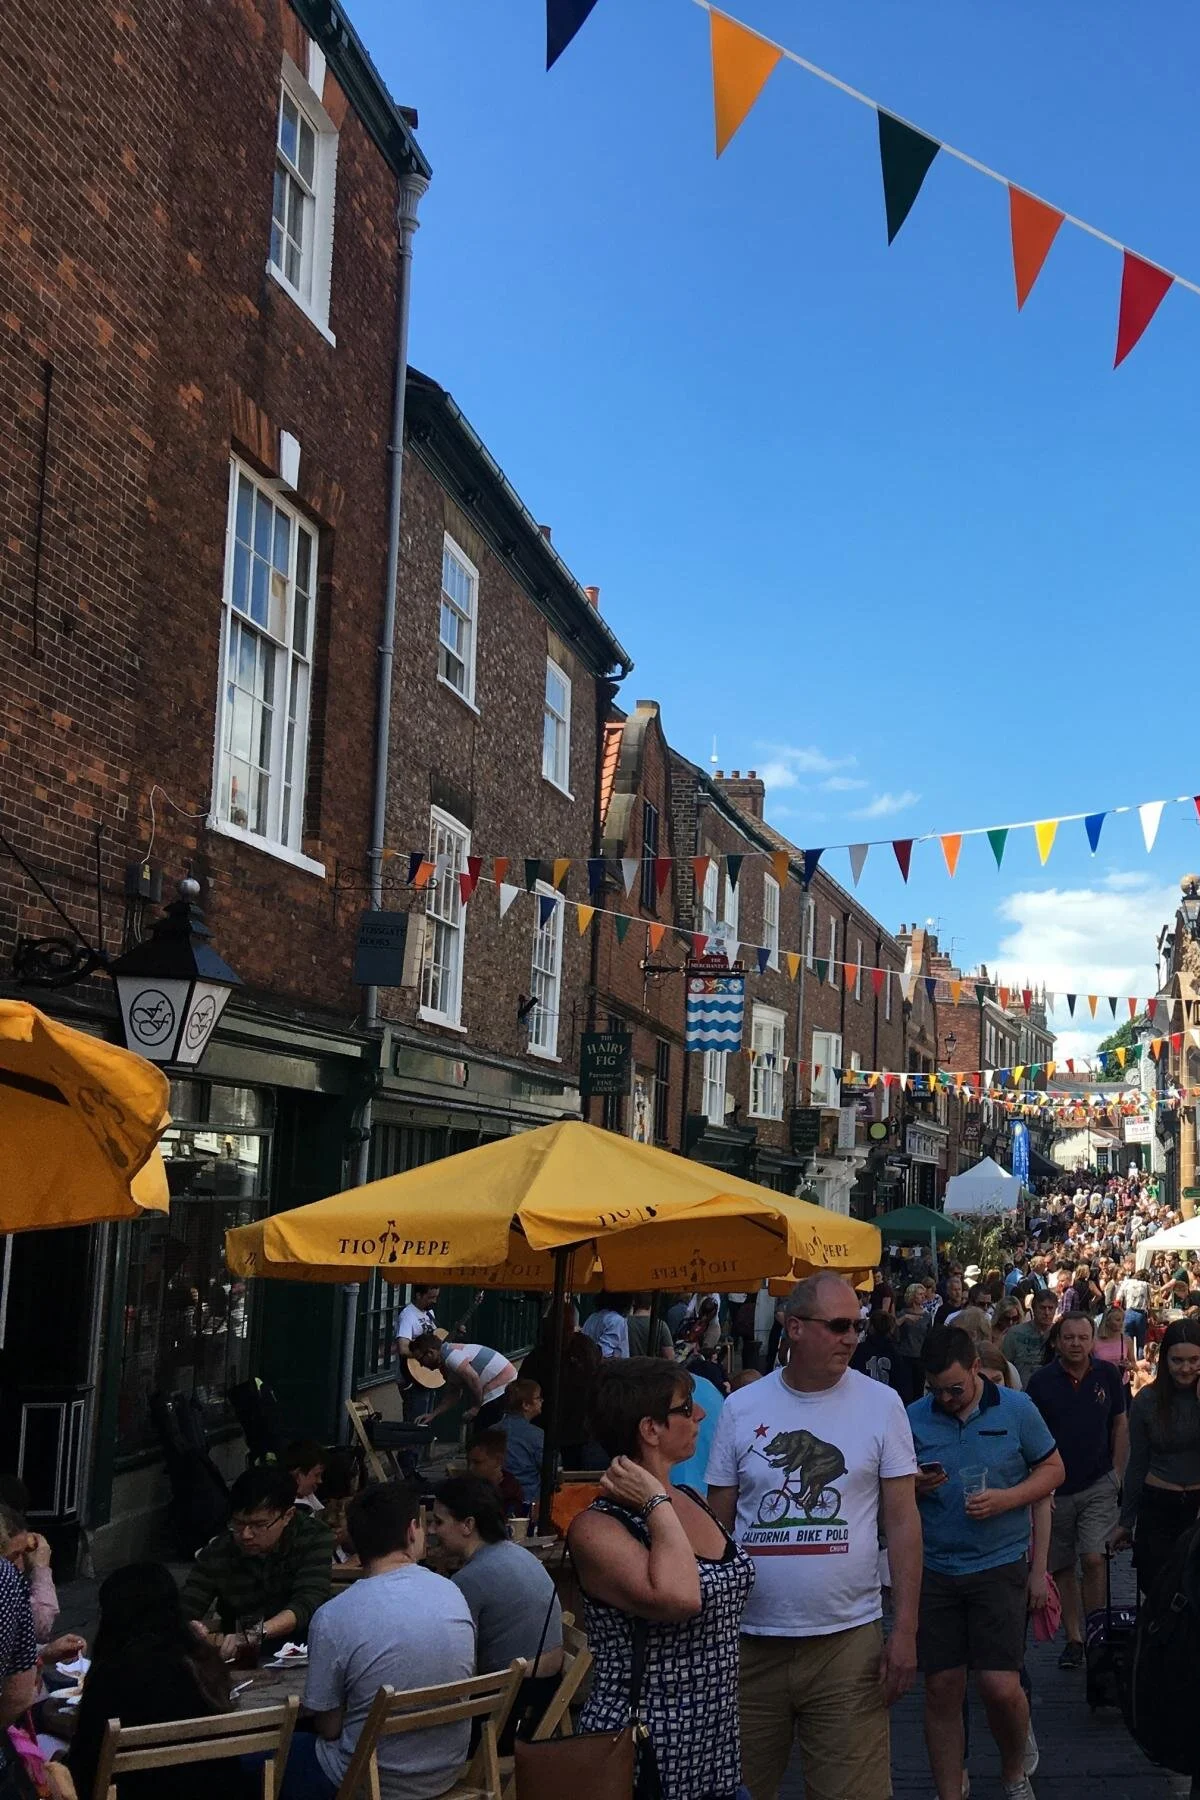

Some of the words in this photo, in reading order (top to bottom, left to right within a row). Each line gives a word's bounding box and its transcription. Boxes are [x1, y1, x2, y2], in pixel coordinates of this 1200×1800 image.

[587, 1042, 626, 1055] HAIRY
[596, 1055, 616, 1066] FIG
[339, 1239, 376, 1254] TIO
[401, 1240, 450, 1255] PEPE
[741, 1530, 790, 1543] CALIFORNIA
[796, 1530, 822, 1542] BIKE
[825, 1529, 848, 1541] POLO
